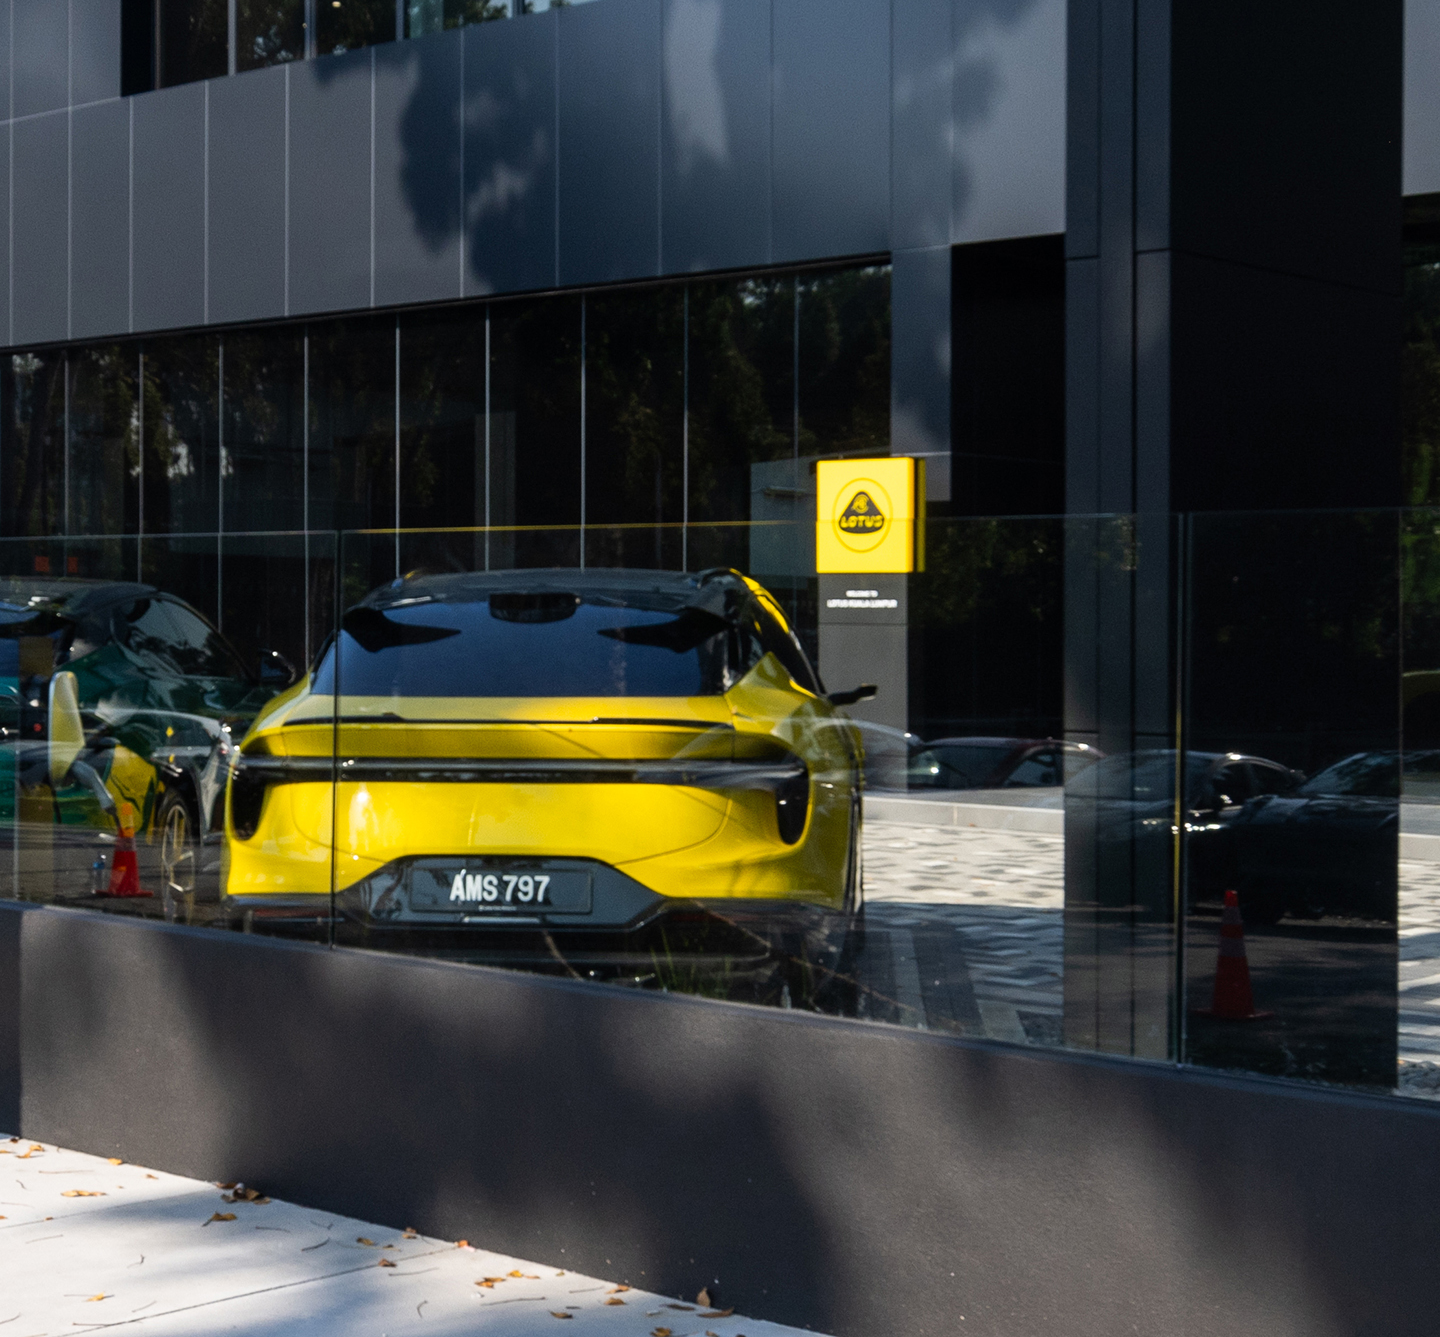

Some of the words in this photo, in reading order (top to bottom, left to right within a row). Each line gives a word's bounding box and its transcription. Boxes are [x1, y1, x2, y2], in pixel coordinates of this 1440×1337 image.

[839, 514, 885, 529] LOTUS
[449, 874, 499, 901] AMS
[502, 874, 551, 902] 797
